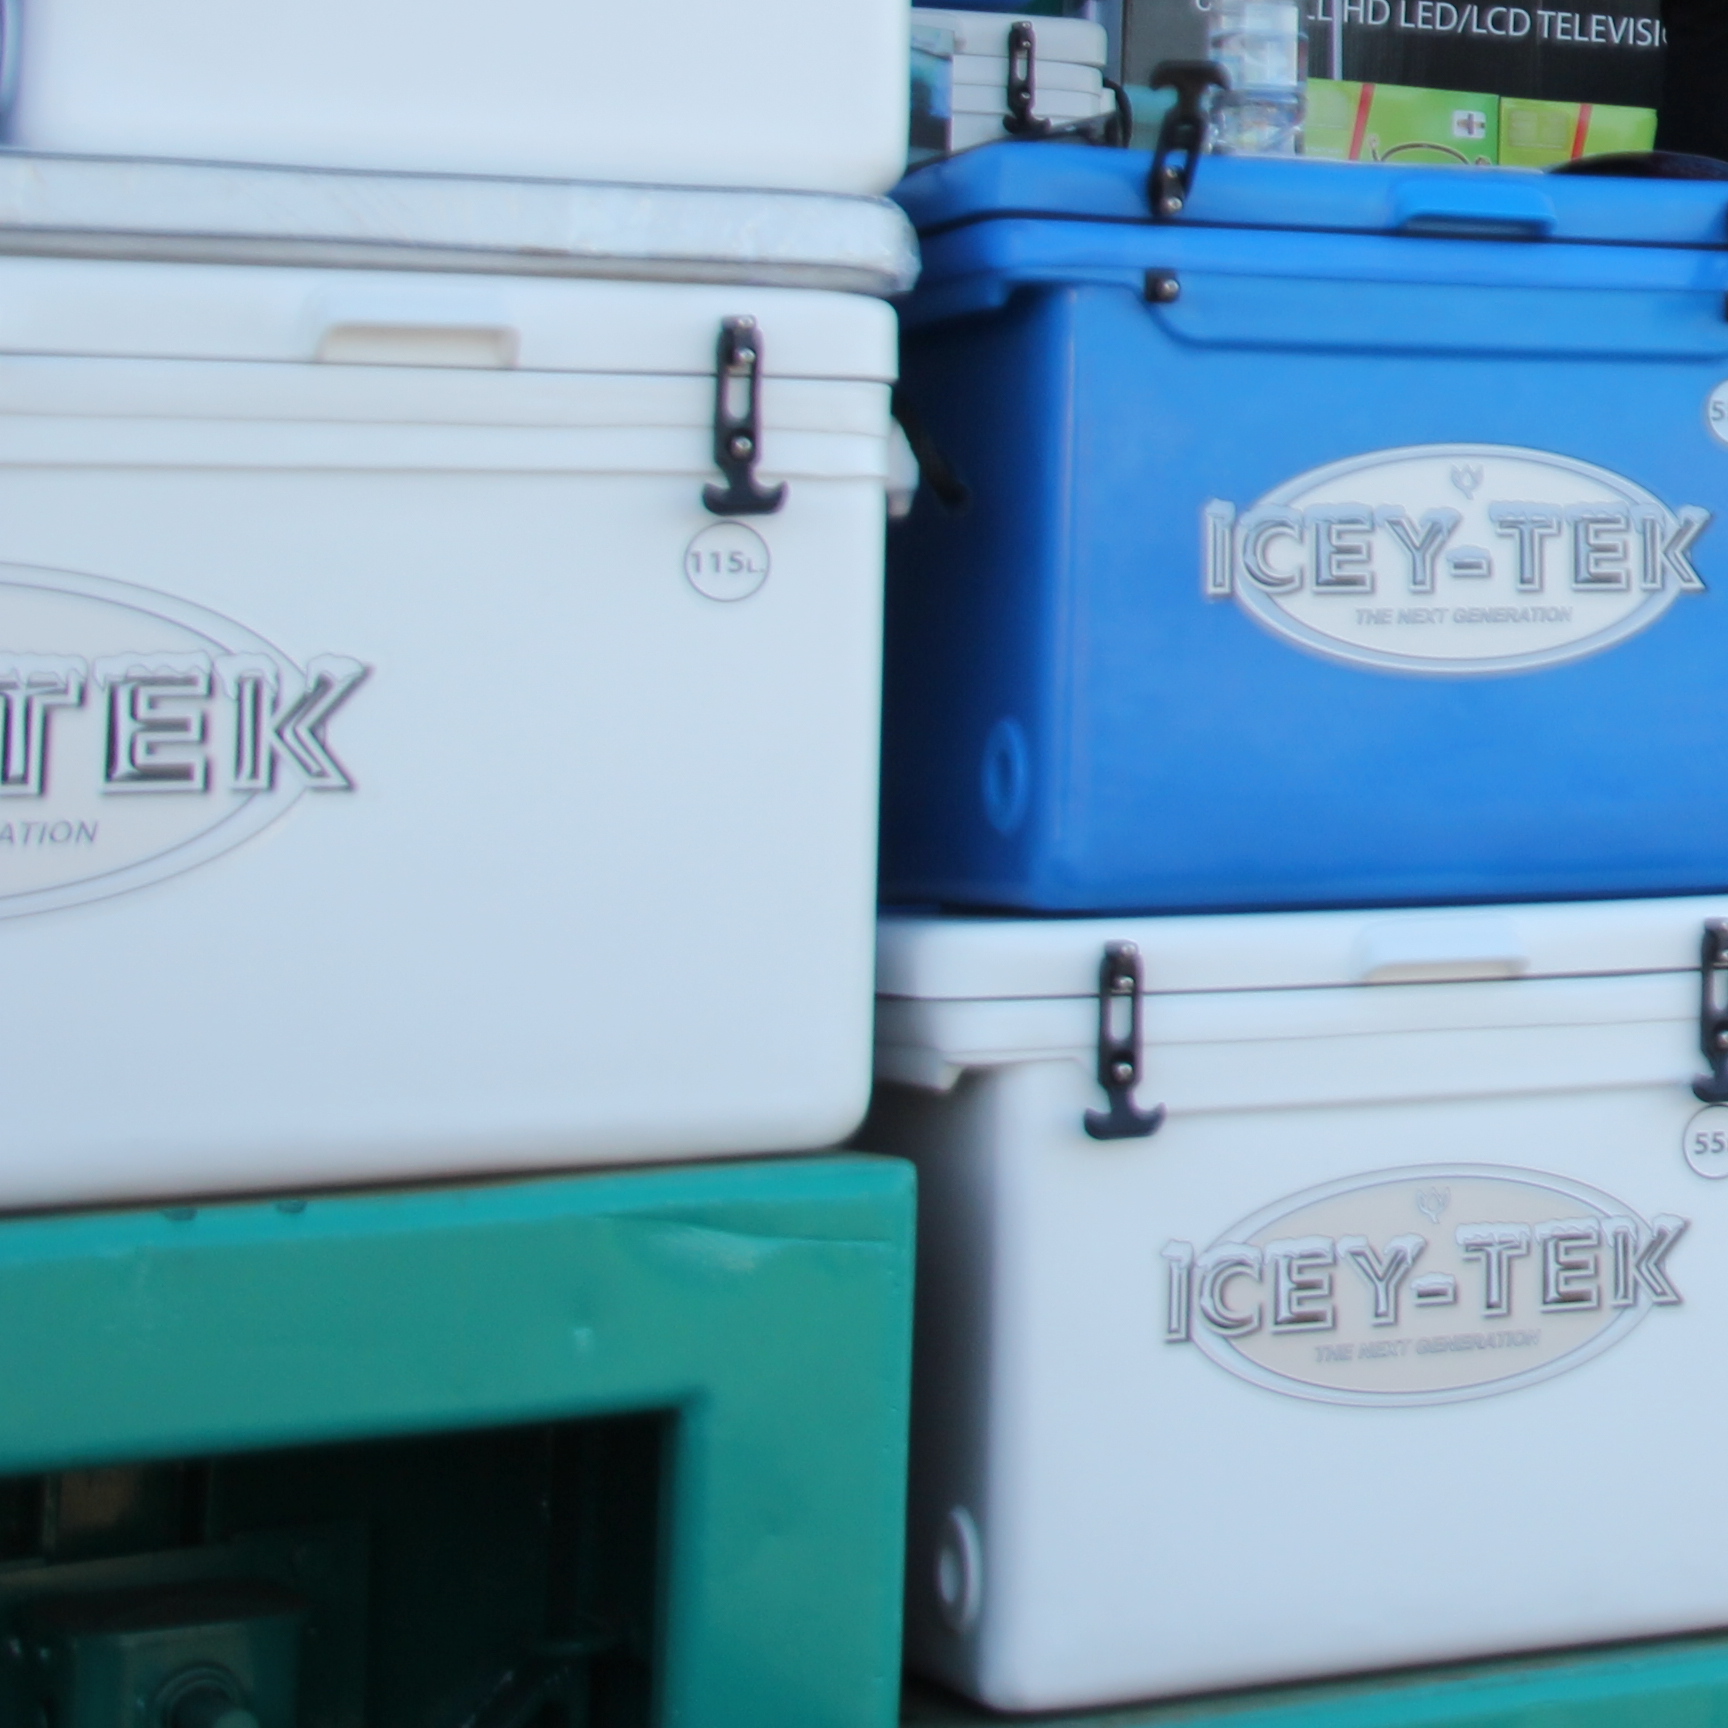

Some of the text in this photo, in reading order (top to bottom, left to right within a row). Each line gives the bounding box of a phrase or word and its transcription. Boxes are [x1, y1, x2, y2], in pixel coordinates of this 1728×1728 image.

[1400, 0, 1531, 36] LED/LCD
[1538, 10, 1667, 46] TELEVISI
[1203, 498, 1713, 598] ICEY-TEK
[1355, 606, 1573, 627] THE NEXT GENERATION
[1161, 1212, 1691, 1345] ICEY-TEK
[1356, 1339, 1412, 1361] NEXT
[1415, 1328, 1543, 1356] GENERATION
